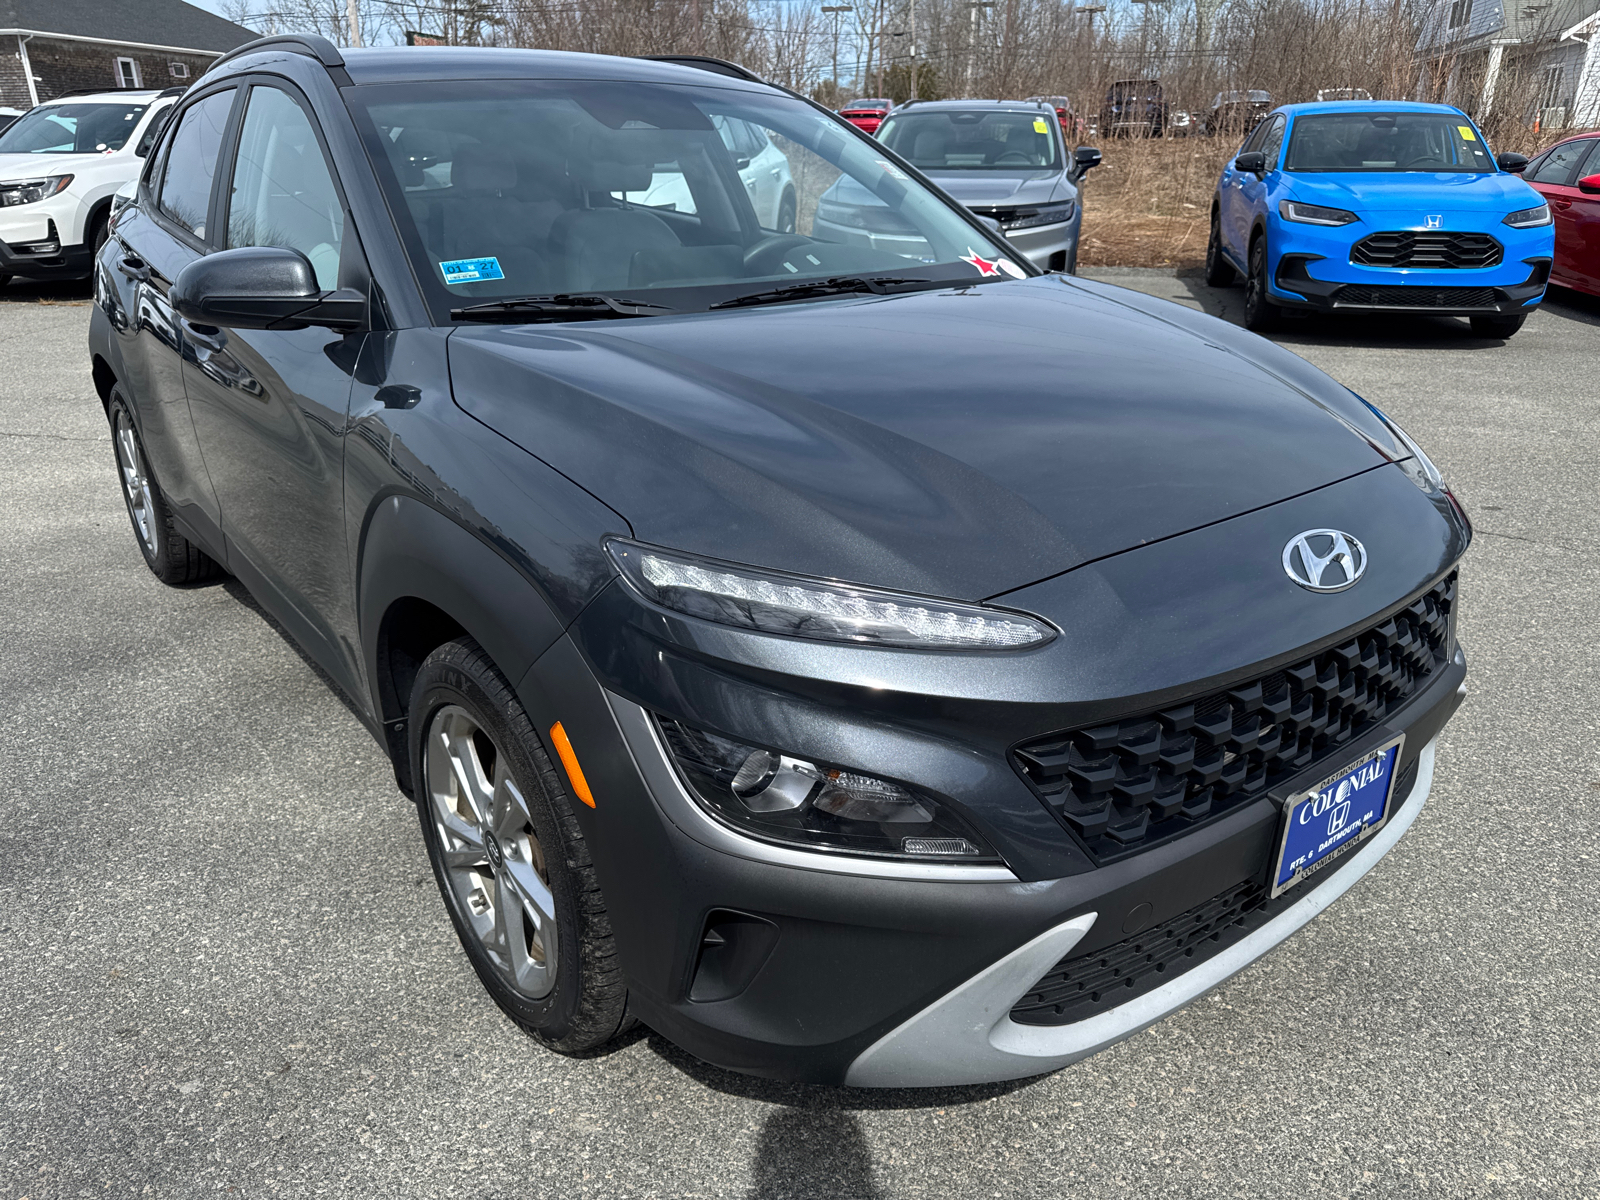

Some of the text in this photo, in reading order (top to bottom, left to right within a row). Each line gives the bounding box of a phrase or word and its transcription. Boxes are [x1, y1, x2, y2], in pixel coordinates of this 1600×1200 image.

[446, 265, 463, 274] 01
[480, 261, 495, 270] 27
[1299, 761, 1385, 825] COLONIAL
[1320, 757, 1365, 789] DARTMOUTH
[1289, 855, 1307, 871] RTE.
[1307, 849, 1314, 859] 6
[1362, 810, 1374, 823] MA
[1301, 836, 1361, 878] COLONIAL HONDA
